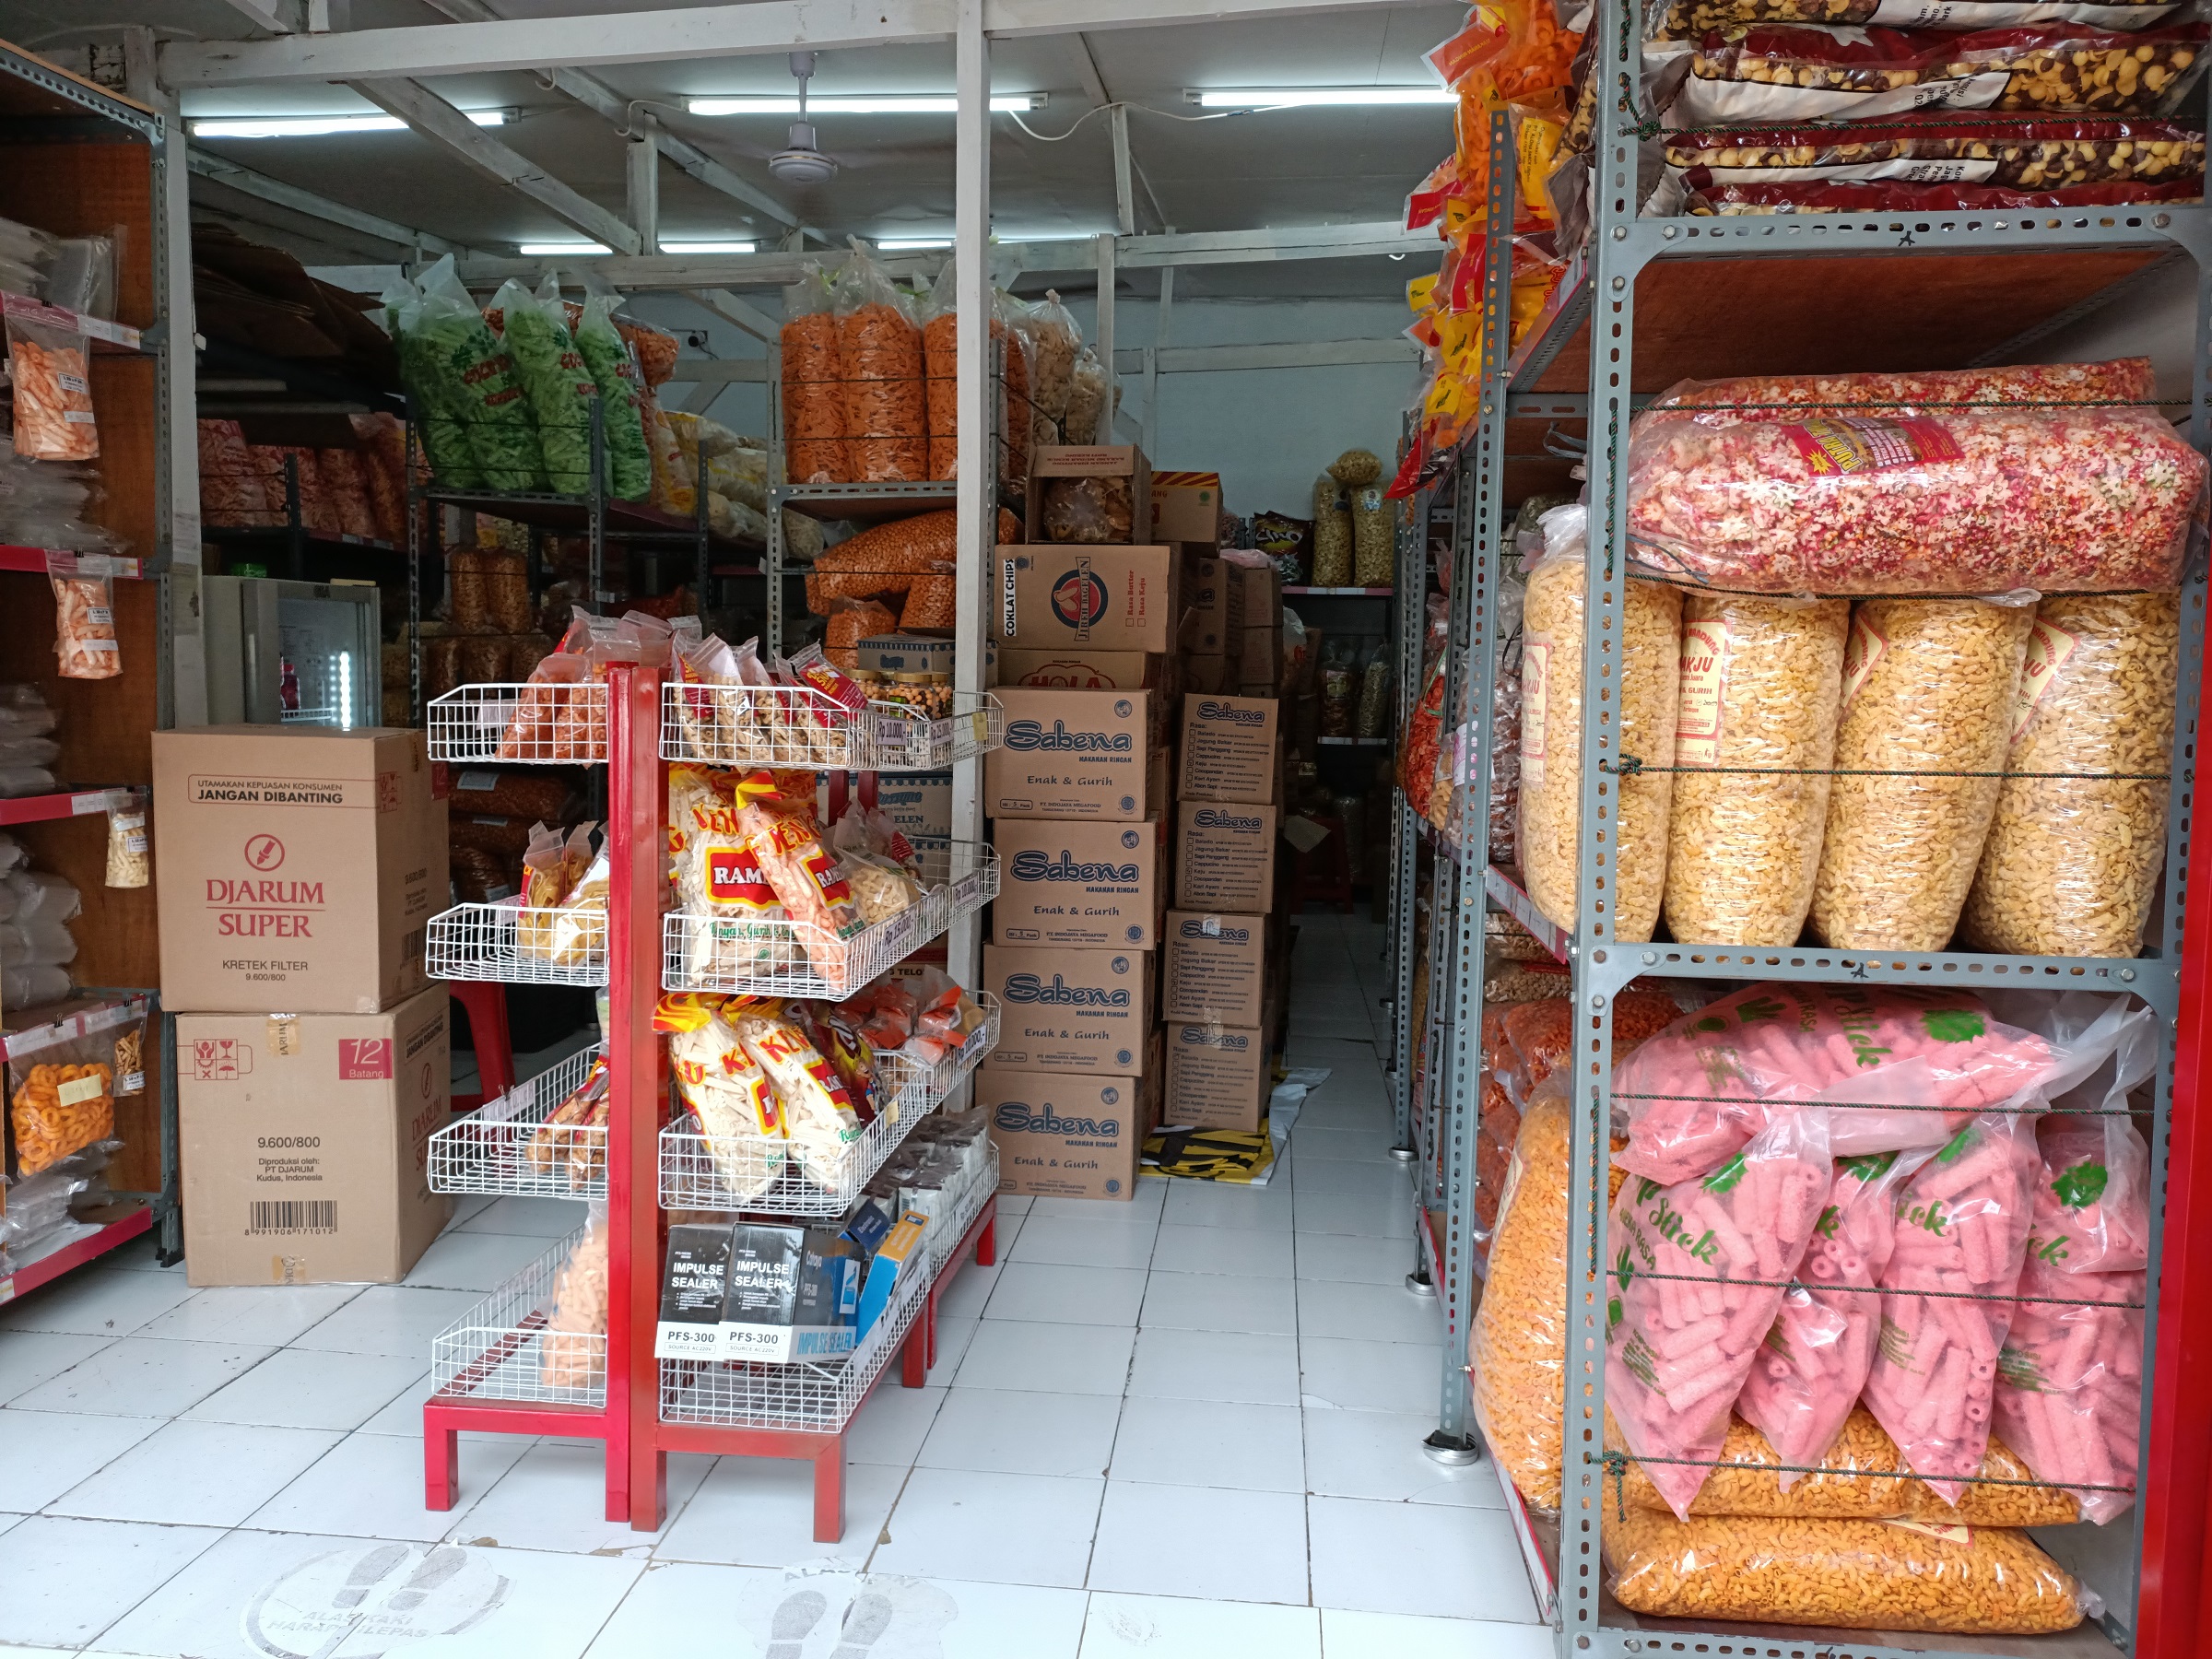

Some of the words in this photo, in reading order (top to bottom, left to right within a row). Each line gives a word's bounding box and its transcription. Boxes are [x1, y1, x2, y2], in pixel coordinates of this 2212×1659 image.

[1816, 434, 1863, 472] PUTRA
[1005, 559, 1015, 591] CHIPS
[1081, 559, 1090, 604] BAGELEN
[1006, 594, 1016, 638] COKLAT
[1077, 606, 1089, 639] JIREH
[1681, 656, 1714, 674] AKJU
[1688, 687, 1712, 695] GURIH
[1197, 702, 1265, 723] Sabena
[879, 722, 885, 741] Rp
[1004, 720, 1132, 751] Sabena
[197, 780, 245, 788] UTAMAKAN
[246, 781, 291, 790] KEPUASAN
[293, 782, 343, 791] KONSUMEN
[1027, 775, 1057, 784] Enak
[1063, 777, 1072, 785] &
[1077, 777, 1112, 786] Gurih
[198, 790, 259, 801] JANGAN
[264, 792, 343, 804] DIBANTING
[1194, 809, 1262, 830] Sabena
[1011, 850, 1139, 882] Sabena
[206, 879, 325, 904] DJARUM
[1033, 906, 1065, 915] Enak
[1069, 907, 1078, 915] &
[1085, 907, 1120, 916] Gurih
[218, 913, 312, 937] SUPER
[222, 960, 268, 971] KRETEK
[270, 961, 309, 971] FILTER
[245, 973, 286, 982] 9.600/800
[1004, 973, 1130, 1007] Sabena
[1025, 1029, 1054, 1037] Enak
[1060, 1030, 1069, 1039] &
[1075, 1031, 1110, 1041] Gurih
[350, 1039, 382, 1065] 12
[348, 1068, 384, 1079] Batang
[994, 1101, 1119, 1137] Sabena
[257, 1136, 321, 1148] 9.600/800
[258, 1158, 300, 1166] Diproduksi
[1015, 1156, 1044, 1166] Enak
[1049, 1159, 1058, 1167] &
[1064, 1159, 1099, 1170] Gurih
[1649, 1197, 1719, 1266] Stick
[673, 1263, 724, 1275] IMPULSE
[736, 1261, 790, 1275] IMPULSE
[671, 1277, 718, 1289] SEALER
[735, 1276, 782, 1288] SEALER
[668, 1331, 715, 1343] PFS-300
[729, 1331, 779, 1344] PFS-300
[797, 1331, 828, 1355] IMPULSE
[828, 1331, 853, 1353] SEALER
[357, 1624, 429, 1638] ILEPAS
